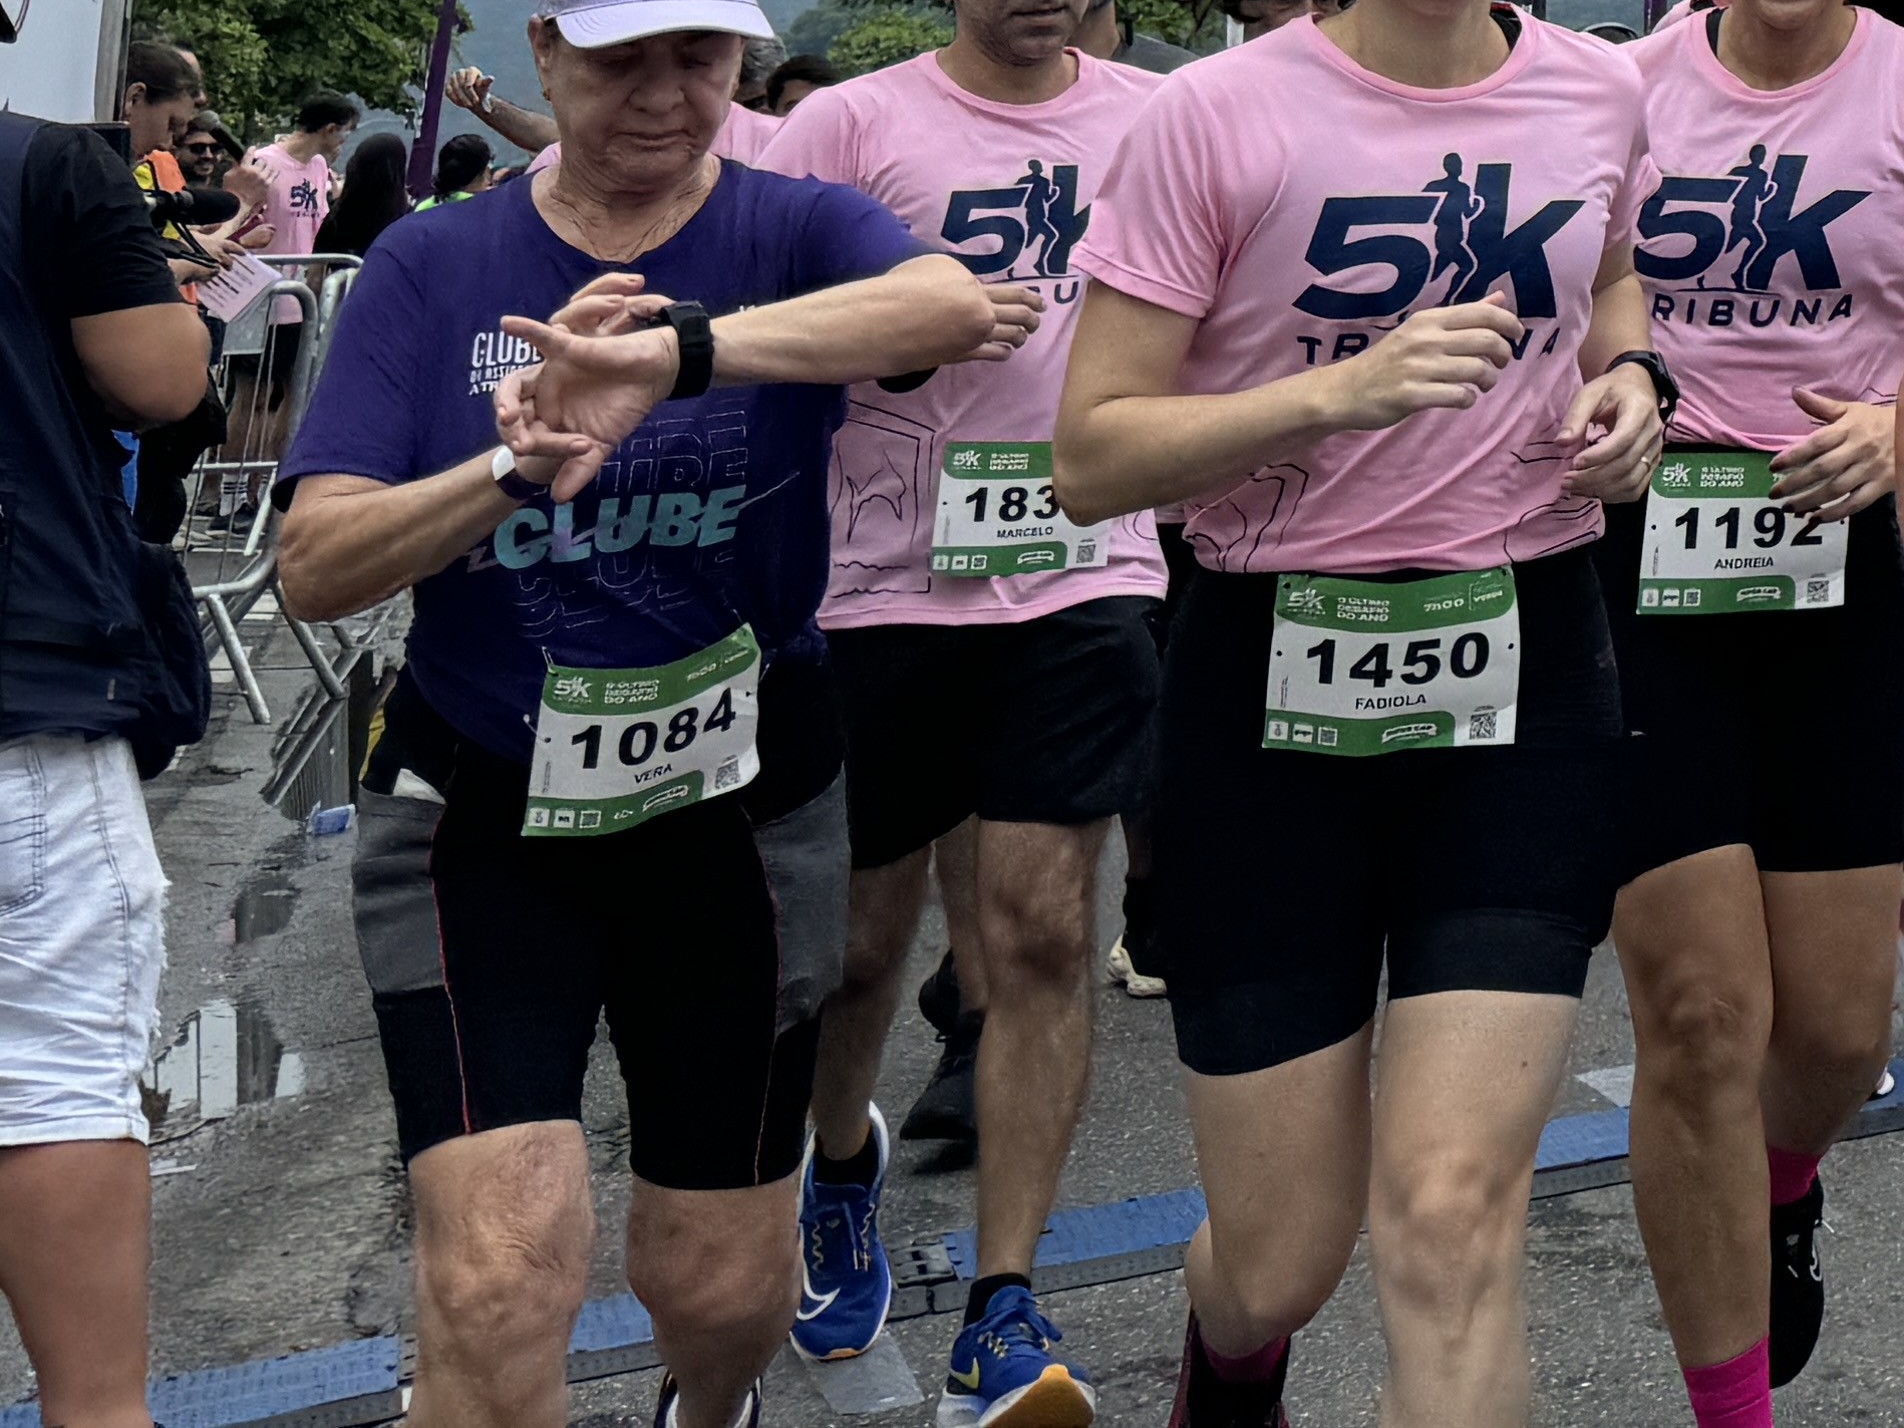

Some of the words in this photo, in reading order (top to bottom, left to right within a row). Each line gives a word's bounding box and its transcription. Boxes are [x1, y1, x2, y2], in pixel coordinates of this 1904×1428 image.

[1653, 294, 1853, 328] RIBUNA
[493, 485, 747, 570] CLUBE
[997, 526, 1054, 538] MARCELO
[1675, 506, 1822, 550] 1192
[1714, 556, 1774, 570] ANDREIA
[1307, 632, 1490, 688] 1450
[571, 687, 736, 770] 1084
[634, 763, 673, 784] VERA
